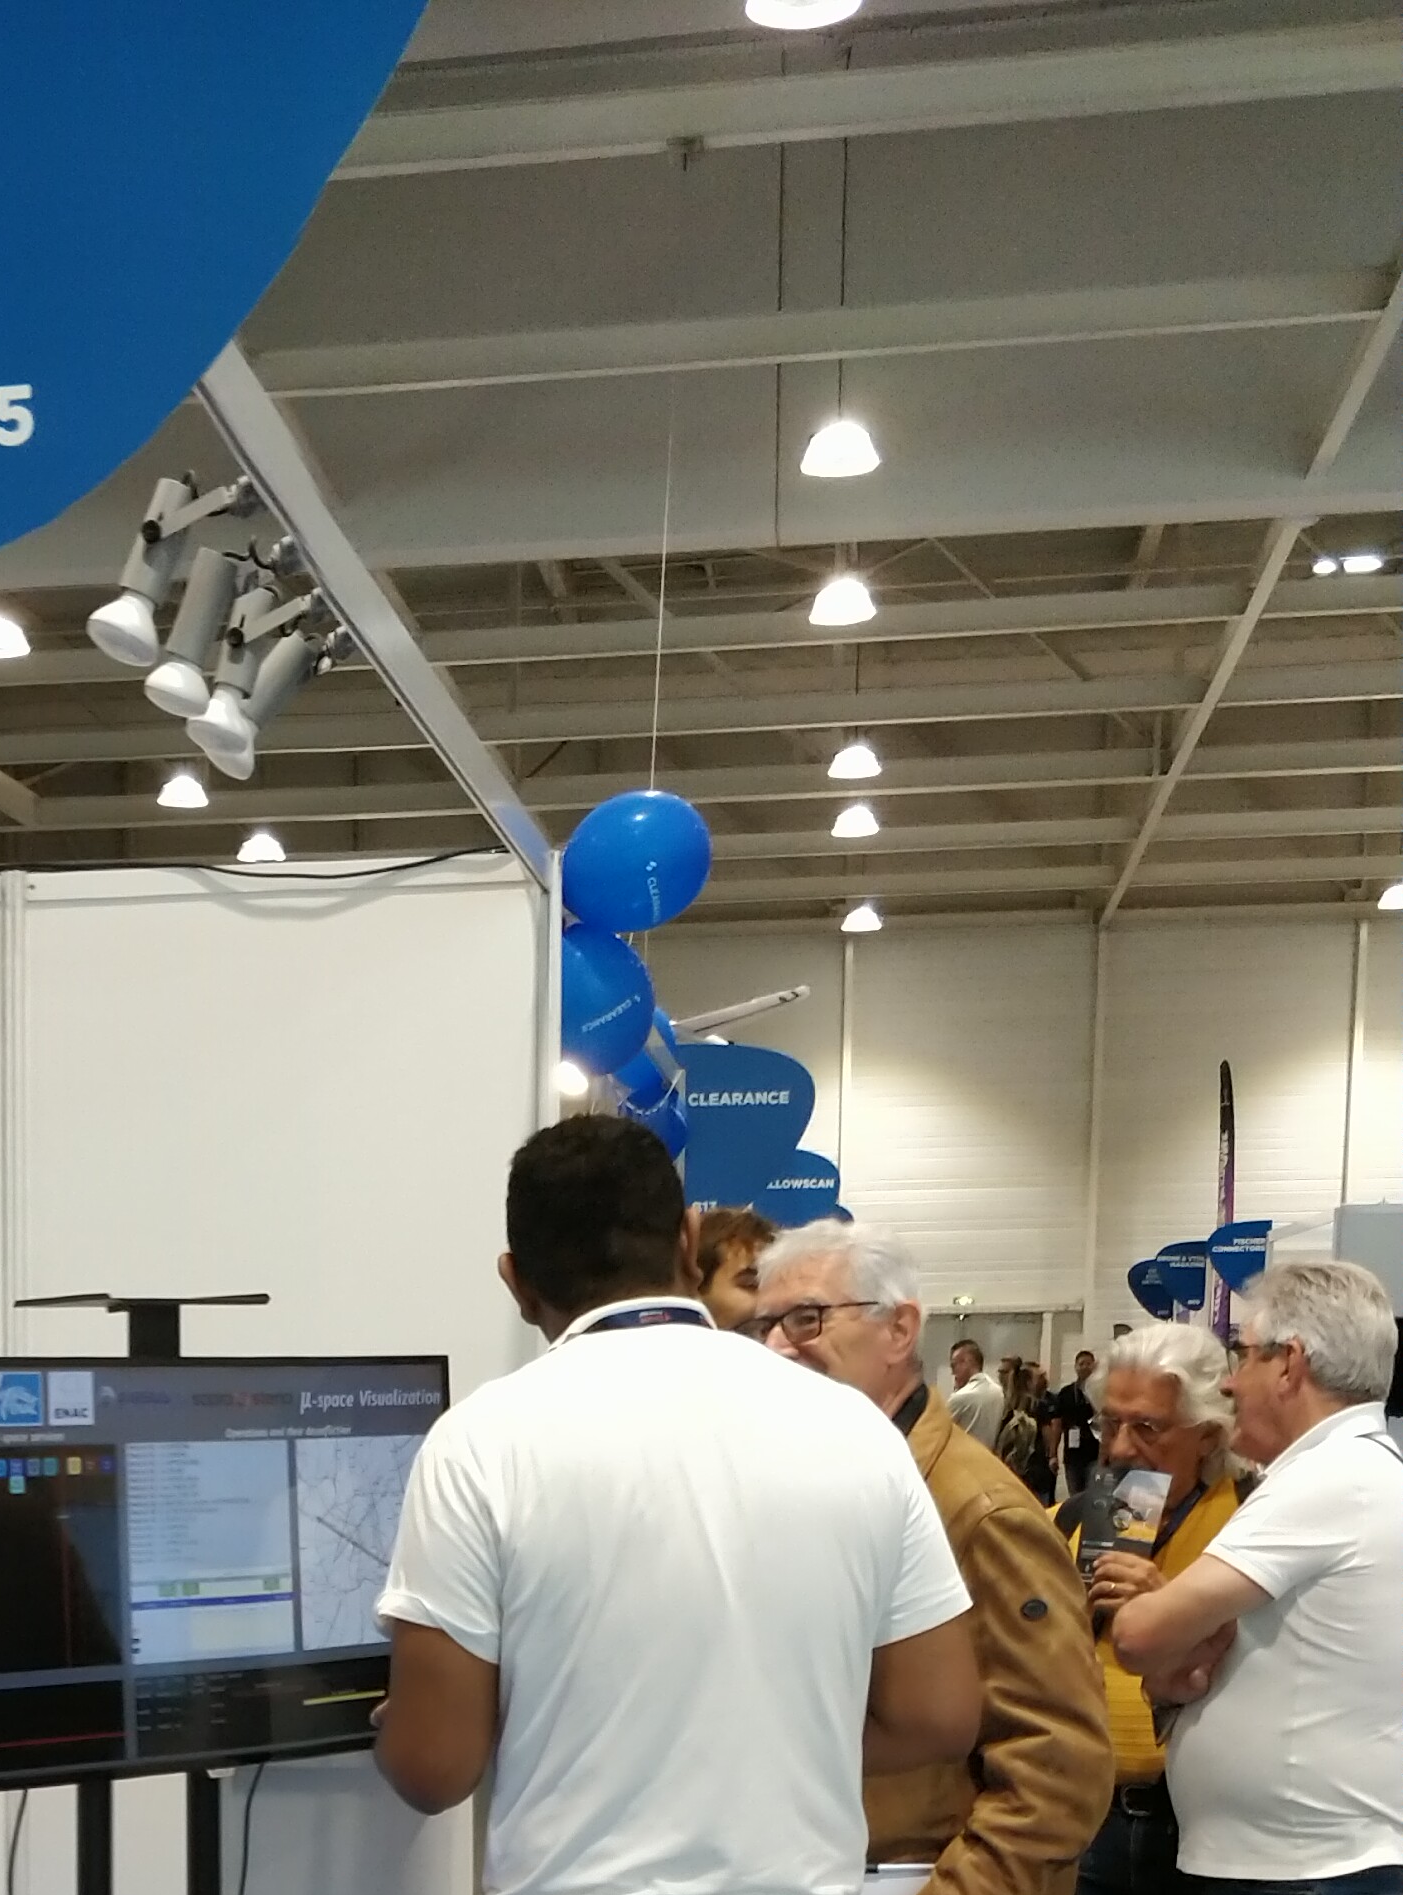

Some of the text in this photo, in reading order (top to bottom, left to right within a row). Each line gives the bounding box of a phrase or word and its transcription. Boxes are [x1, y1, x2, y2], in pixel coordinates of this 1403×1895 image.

[687, 1090, 790, 1107] CLEARANCE
[1211, 1245, 1266, 1253] CONNECTORS
[359, 1388, 441, 1407] Visualization
